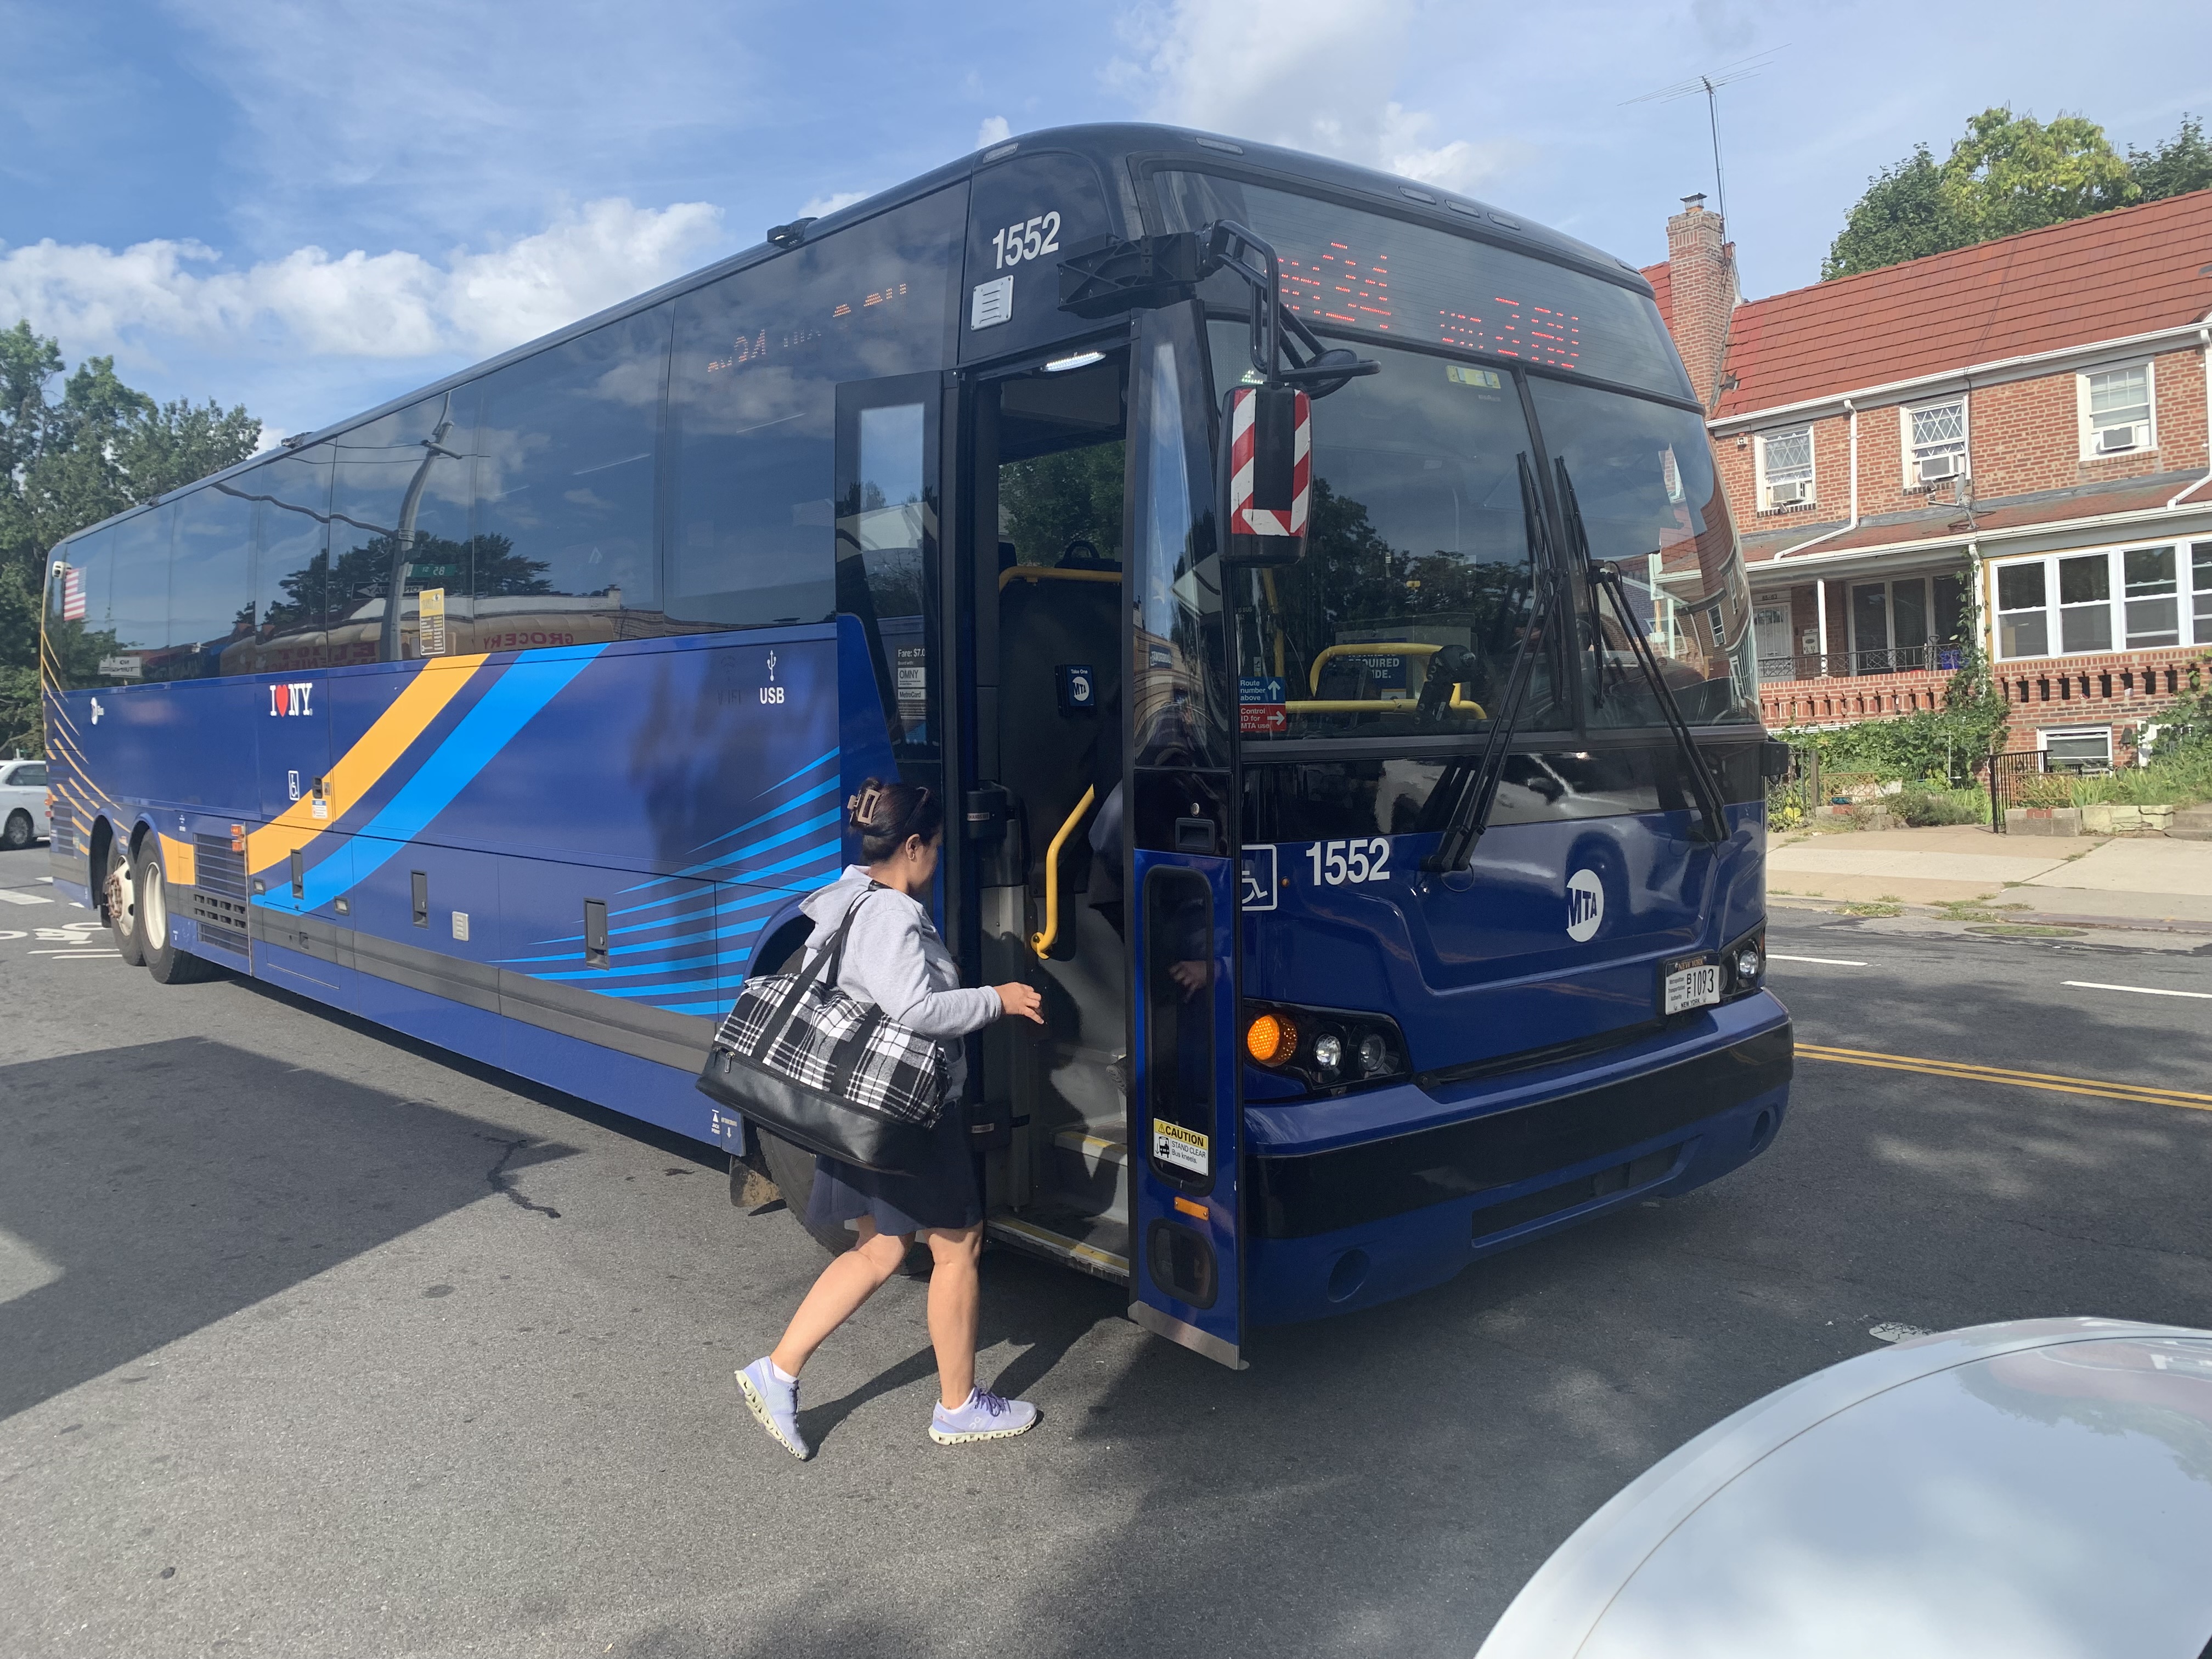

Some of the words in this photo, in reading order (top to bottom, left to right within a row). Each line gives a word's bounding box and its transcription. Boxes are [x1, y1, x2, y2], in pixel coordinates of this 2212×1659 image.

[992, 211, 1060, 269] 1552
[898, 649, 912, 658] Fare:
[1348, 658, 1400, 668] UIRED
[899, 670, 919, 679] OMNY
[1371, 669, 1391, 679] IDE.
[270, 685, 277, 716] I
[288, 682, 313, 716] NY
[760, 687, 785, 704] USB
[1306, 837, 1390, 885] 1552
[1693, 968, 1714, 997] 1093
[1165, 1126, 1204, 1147] CAUTION
[1172, 1141, 1189, 1152] STAND
[1189, 1147, 1206, 1159] CLEAR
[1172, 1149, 1181, 1158] Bus
[1181, 1153, 1198, 1164] kneels.
